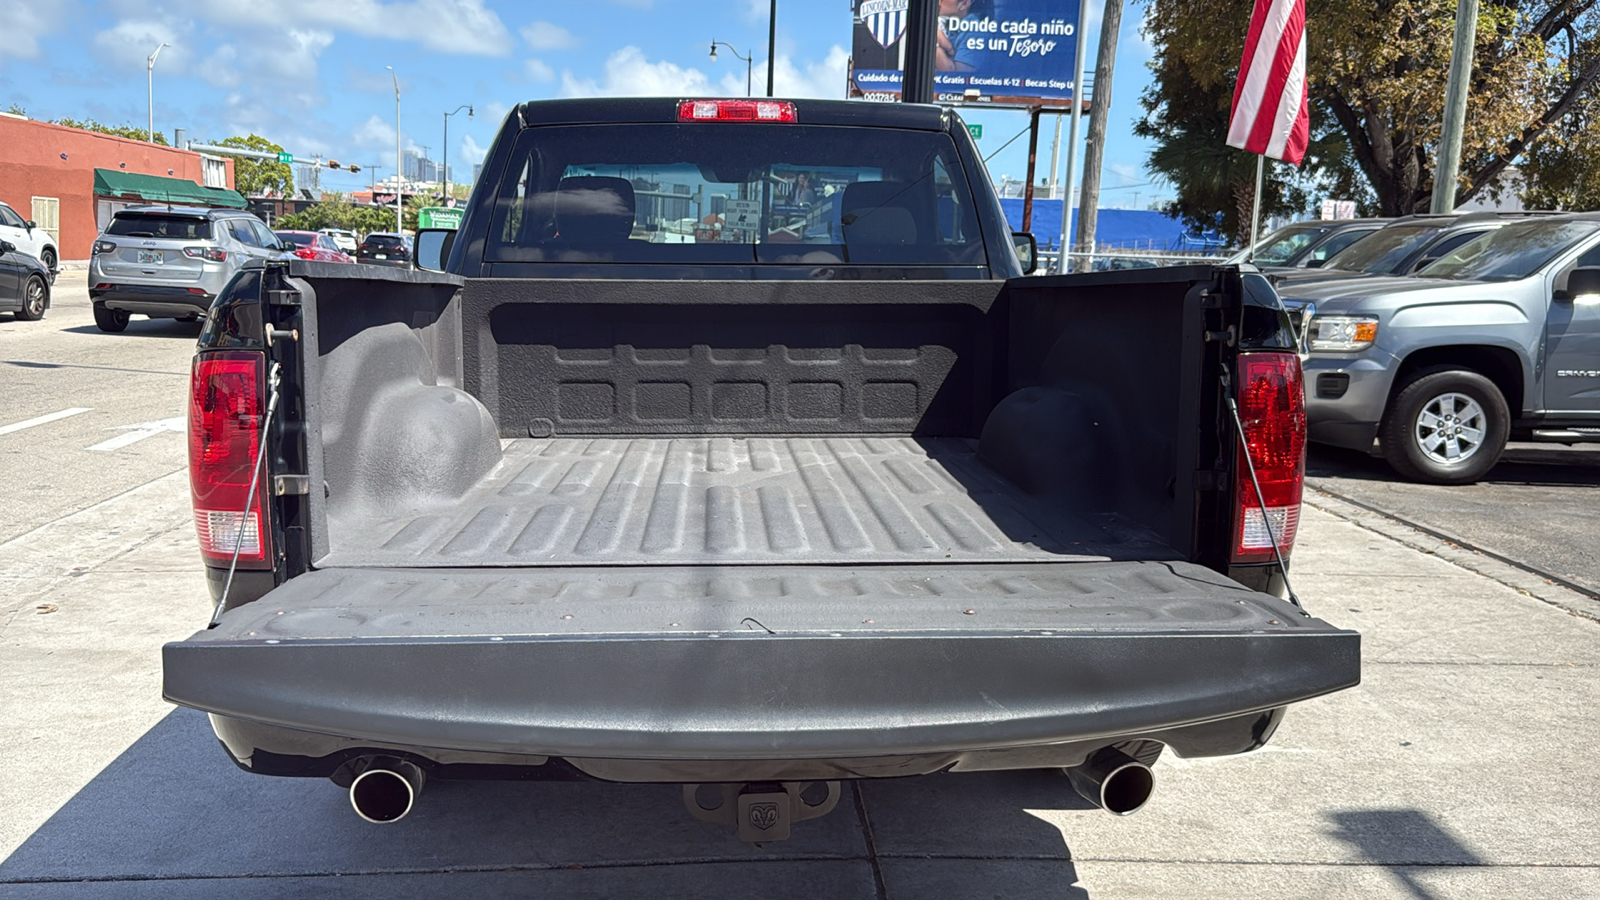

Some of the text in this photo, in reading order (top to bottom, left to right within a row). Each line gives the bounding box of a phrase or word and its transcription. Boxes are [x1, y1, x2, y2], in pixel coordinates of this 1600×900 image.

[949, 16, 1074, 36] Donde cada niño
[966, 34, 1056, 57] es un Tesoro
[857, 73, 889, 83] Cuidado
[889, 74, 899, 83] de
[942, 76, 965, 85] Gratis
[969, 76, 1020, 87] Escuelas K-12
[1025, 79, 1047, 88] Becas
[1048, 80, 1065, 90] Step
